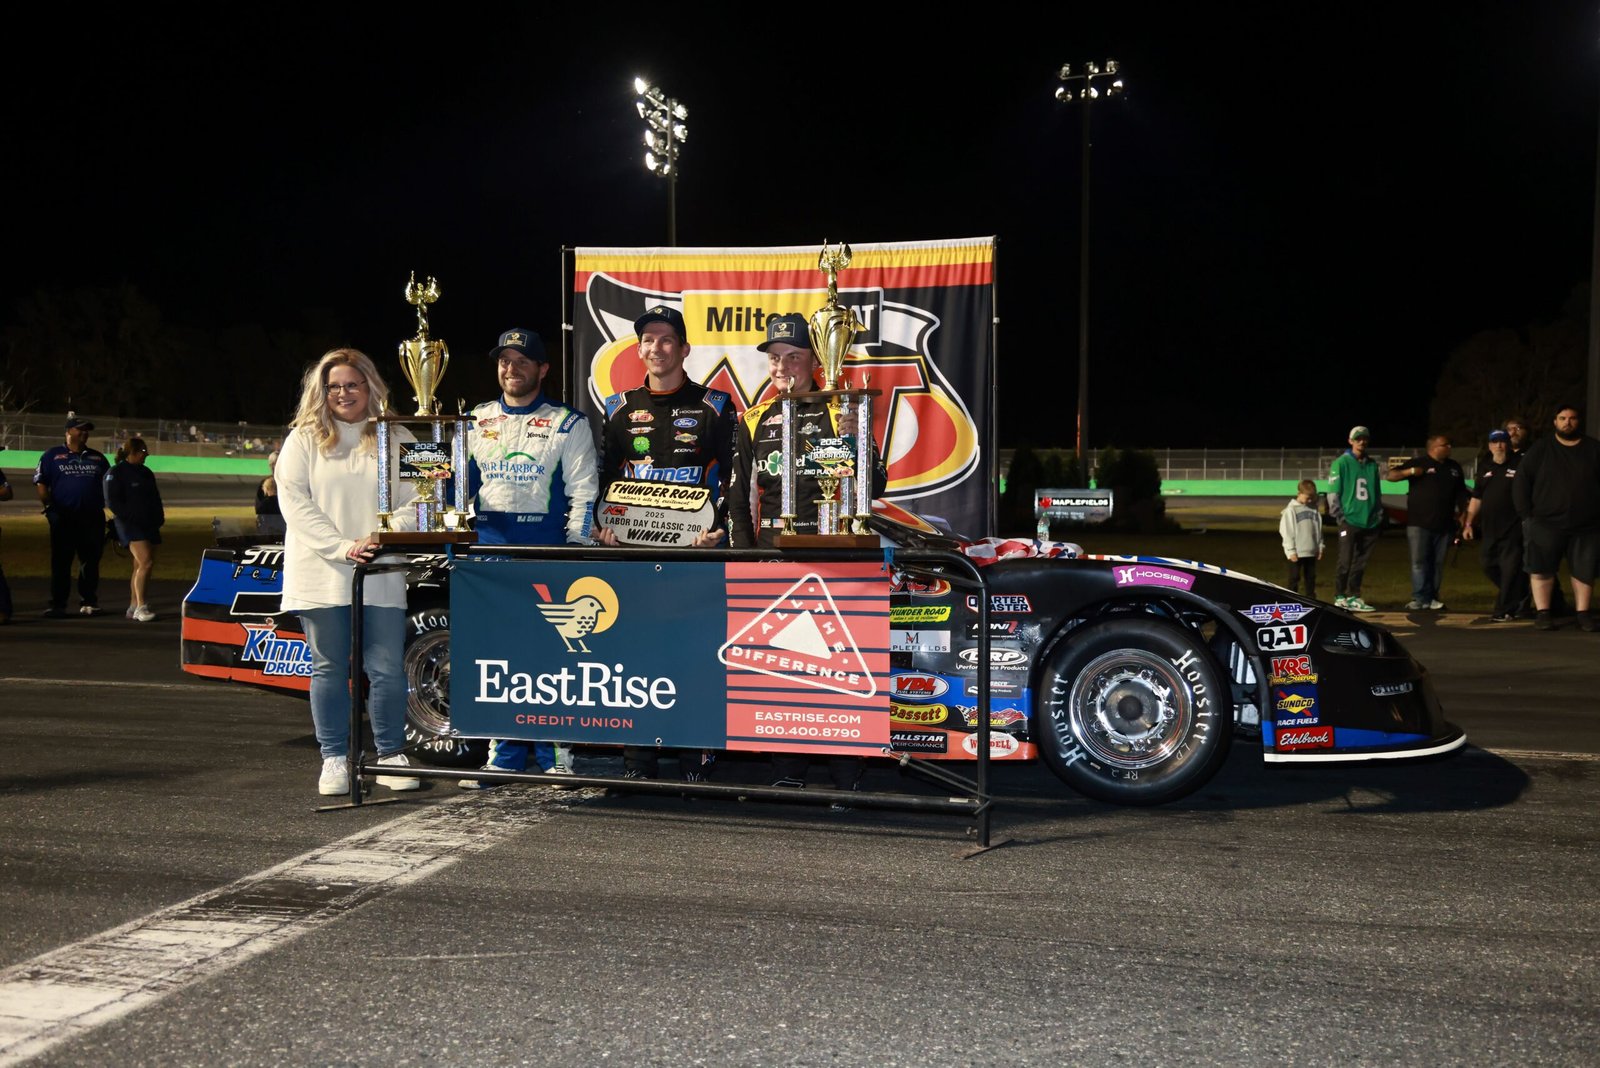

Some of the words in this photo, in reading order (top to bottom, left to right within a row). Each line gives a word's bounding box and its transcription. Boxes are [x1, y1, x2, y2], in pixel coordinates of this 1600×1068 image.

[707, 307, 803, 332] Milt
[820, 438, 843, 446] 2025
[500, 461, 545, 475] HARBOR
[612, 483, 670, 498] THUNDER
[670, 488, 706, 501] ROAD
[1356, 478, 1368, 500] 6
[1052, 498, 1109, 506] MAPLEFIELDS
[645, 511, 665, 519] 2025
[605, 516, 631, 526] LABOR
[633, 519, 649, 528] DAY
[651, 520, 685, 531] CLASSIC
[687, 524, 702, 533] 200
[627, 528, 682, 544] WINNER
[1136, 571, 1189, 585] HOOSIER
[890, 608, 923, 616] HUNDER
[924, 608, 946, 616] ROAD
[991, 603, 1029, 612] ASTER
[1252, 605, 1275, 615] FIVE
[1279, 604, 1302, 612] STAR
[761, 599, 804, 635] ALL
[814, 602, 846, 654] THE
[242, 629, 312, 661] Kinne
[1258, 626, 1304, 649] QA1
[264, 661, 313, 675] DRUGS
[731, 645, 860, 685] DIFFERENCE
[1272, 656, 1311, 677] KRC
[475, 659, 677, 709] EastRise
[896, 676, 937, 692] VDL
[1171, 649, 1213, 745] Hoosier
[1277, 698, 1314, 709] SUNOCO
[515, 713, 575, 726] CREDIT
[580, 716, 634, 729] UNION
[755, 711, 861, 724] EASTRISE.COM
[890, 705, 941, 721] Bassett
[1050, 673, 1087, 767] Hoosier
[1297, 717, 1319, 725] FUELS
[755, 725, 861, 739] 800.400.8790
[892, 734, 945, 742] ALLSTAR
[1280, 731, 1329, 746] Edelbrock
